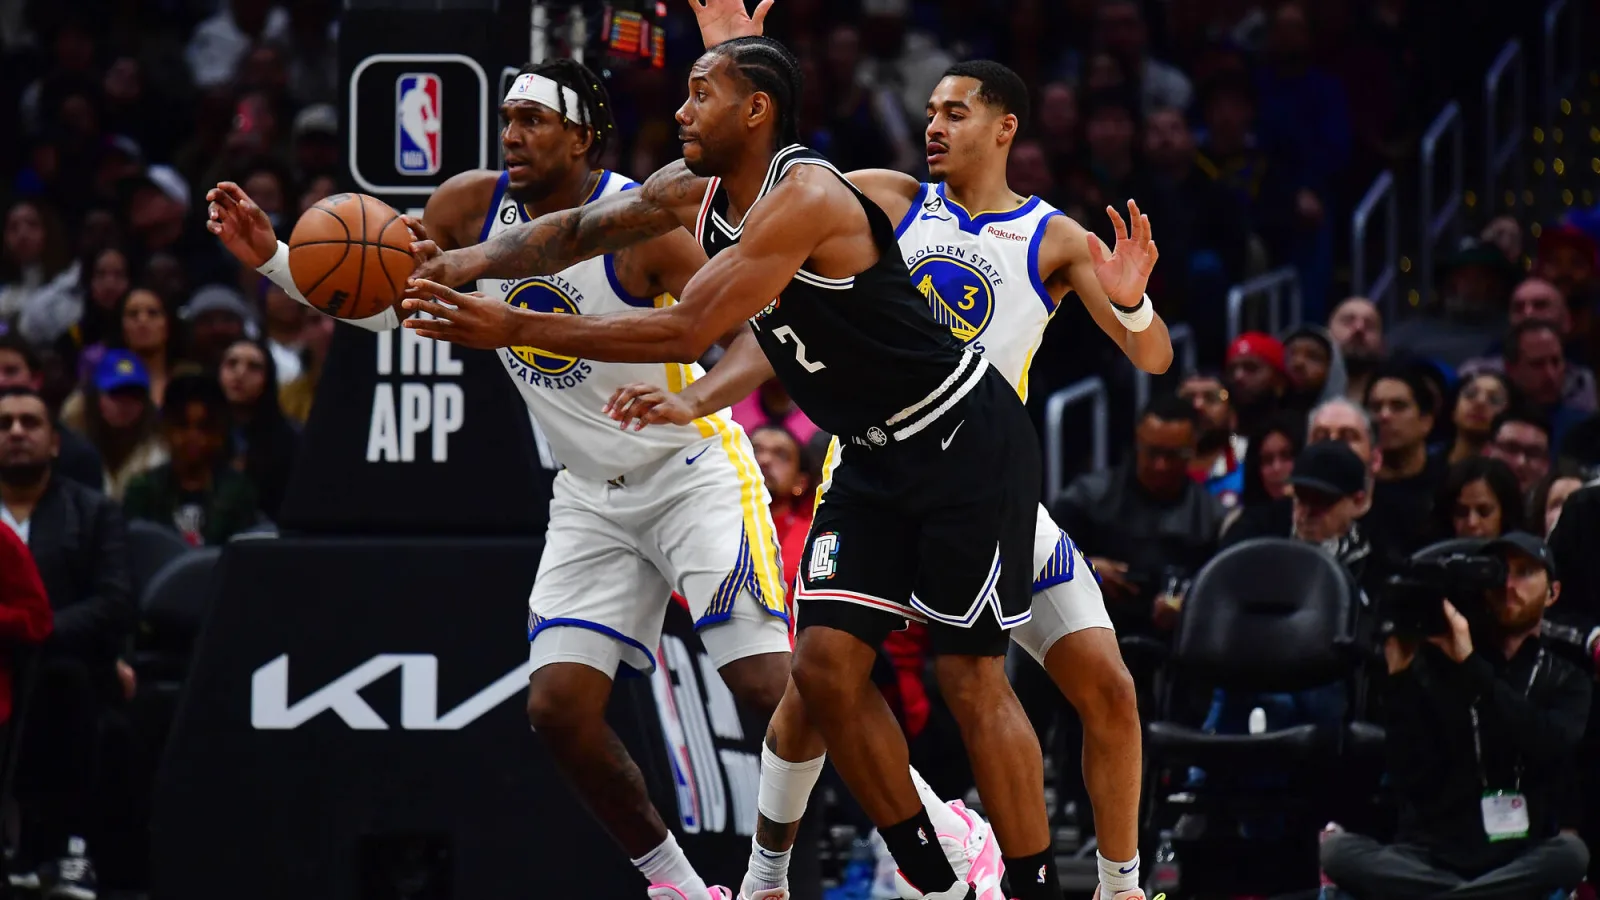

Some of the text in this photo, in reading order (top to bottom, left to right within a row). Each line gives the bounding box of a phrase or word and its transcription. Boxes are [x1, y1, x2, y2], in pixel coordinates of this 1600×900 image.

[503, 206, 516, 223] 6
[987, 226, 1028, 242] Rakuten
[907, 245, 1003, 286] GOLDEN STATE
[548, 274, 584, 304] STATE
[957, 285, 979, 310] 3
[772, 325, 827, 373] 2
[506, 351, 592, 390] WARRIORS
[366, 382, 464, 462] APP
